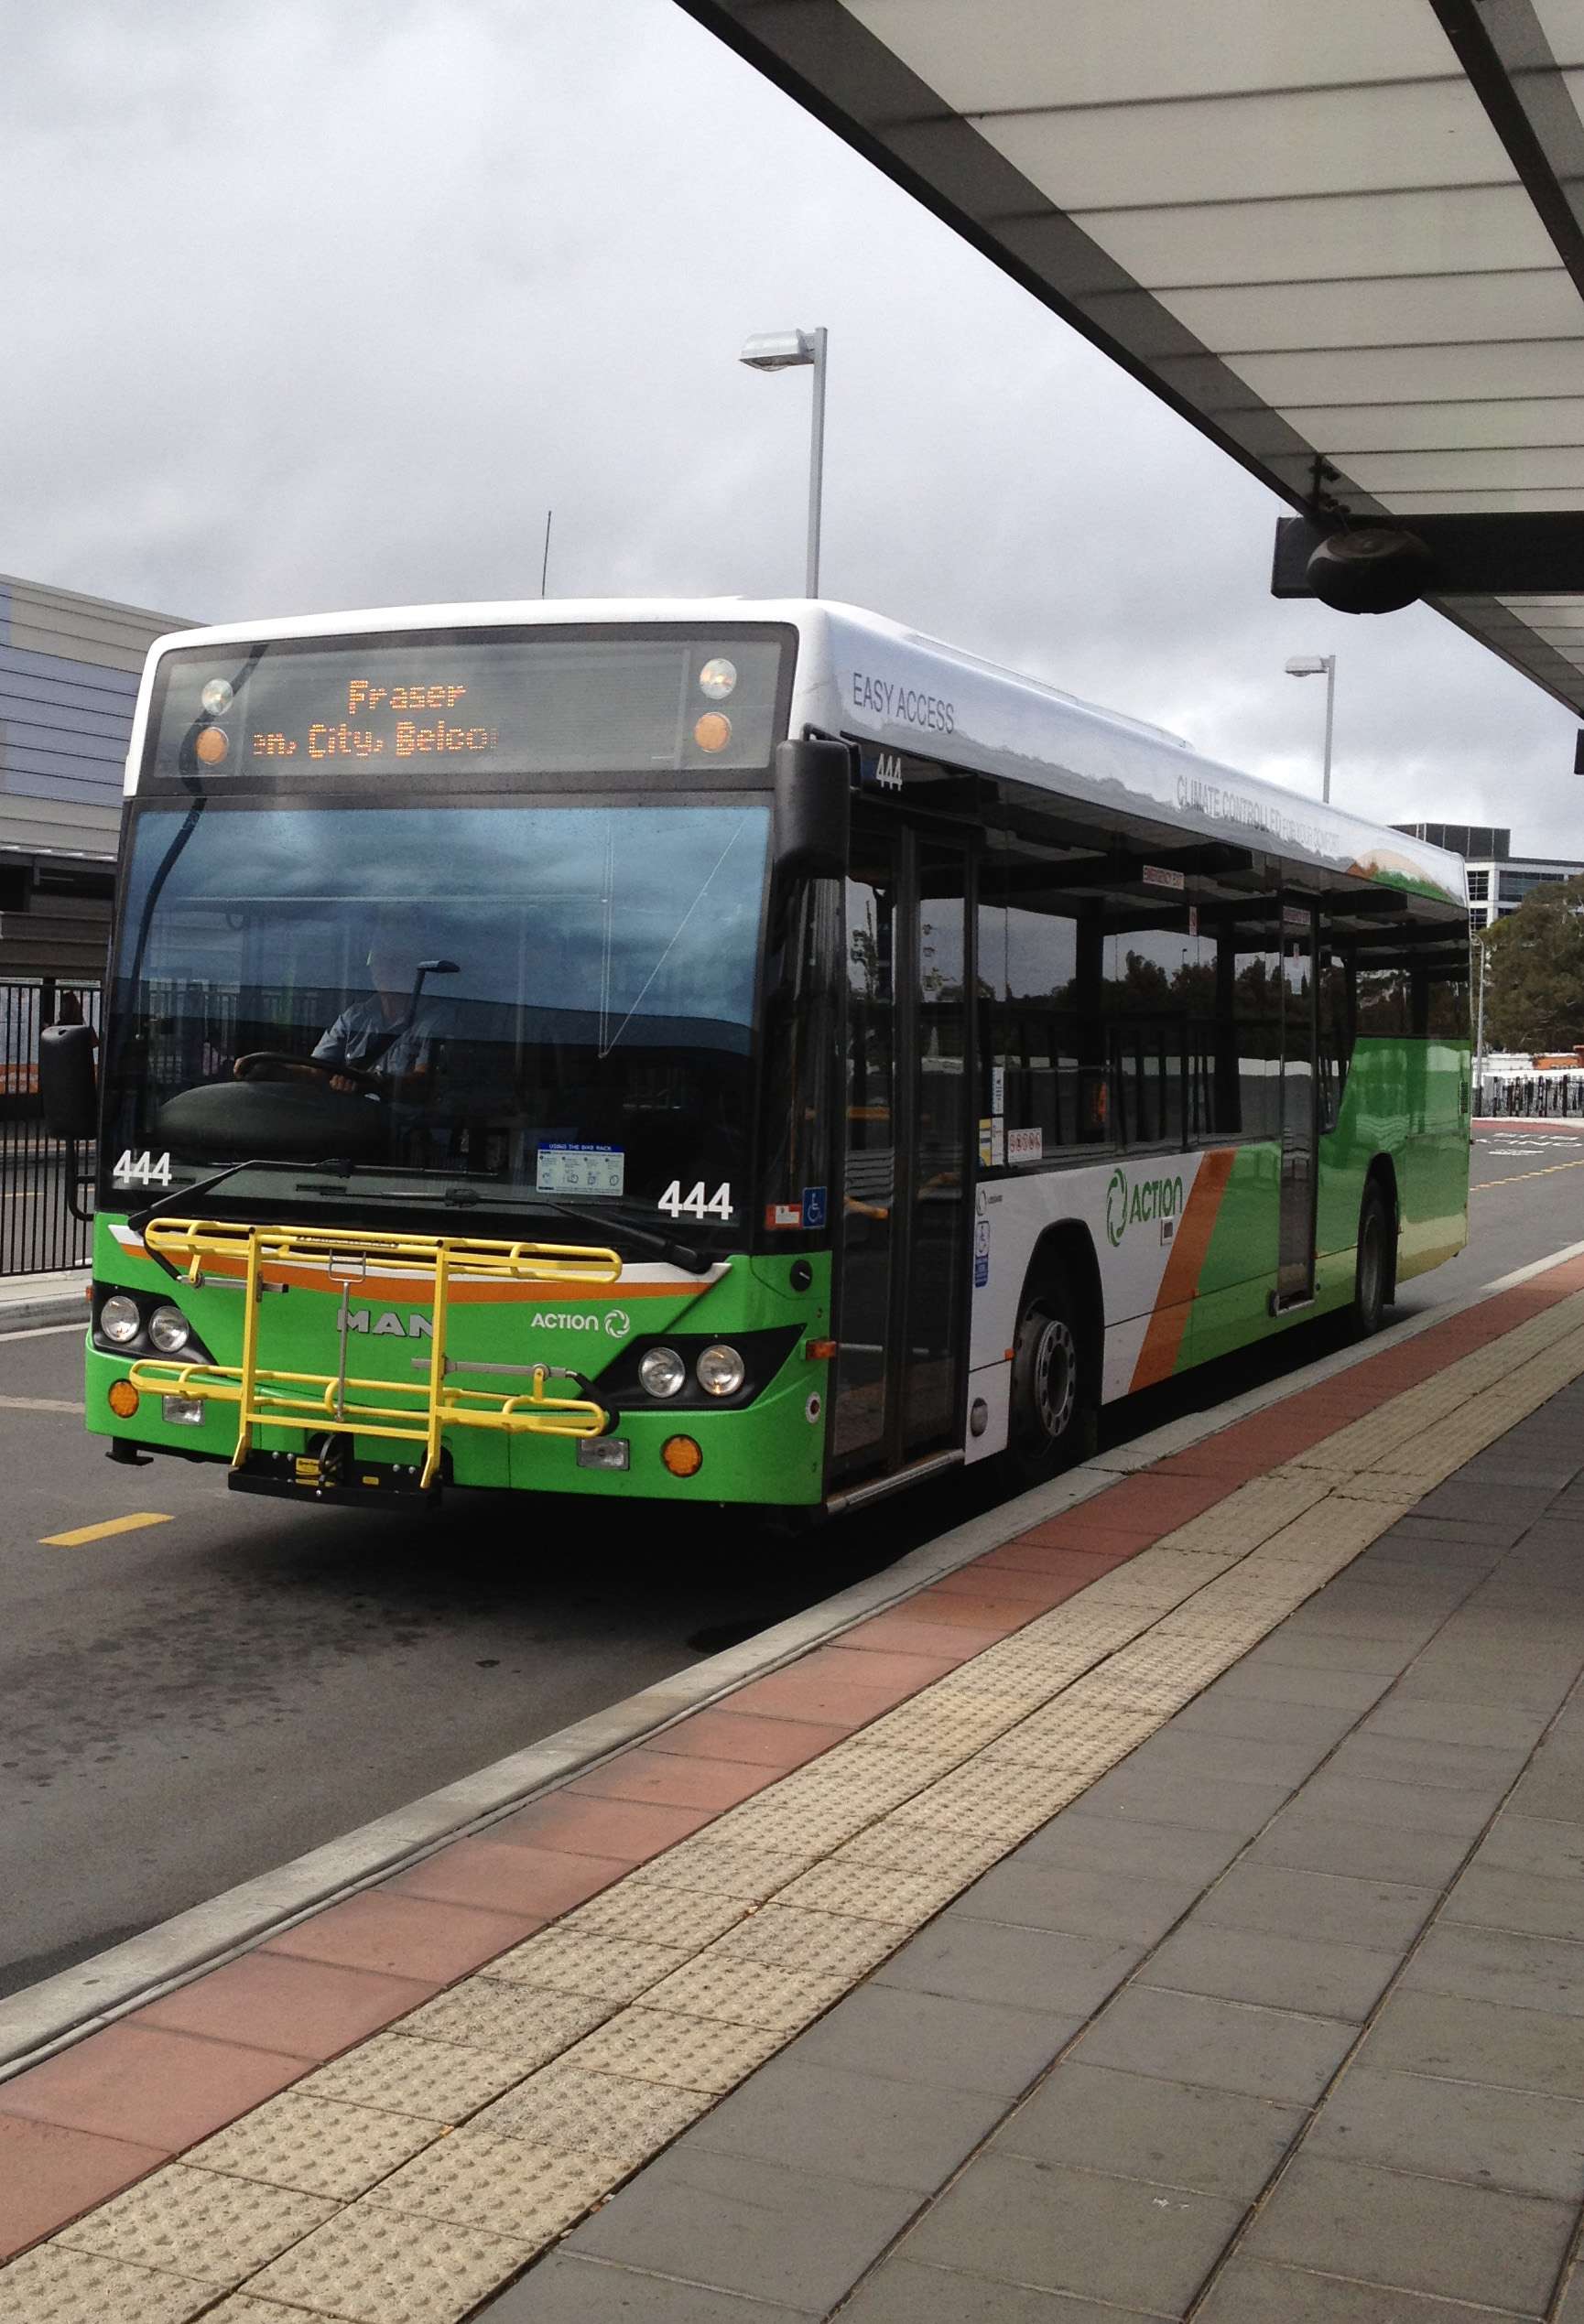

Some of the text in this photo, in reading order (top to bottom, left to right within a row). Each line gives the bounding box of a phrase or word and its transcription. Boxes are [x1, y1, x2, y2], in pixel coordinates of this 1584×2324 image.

[348, 679, 466, 715] Fraser
[853, 672, 954, 734] EASY ACCESS
[875, 753, 903, 792] 444
[113, 1150, 173, 1186] 444
[657, 1180, 733, 1220] 444
[1129, 1175, 1184, 1224] ACTION
[337, 1309, 434, 1338] MAN
[530, 1313, 599, 1331] ACTION
